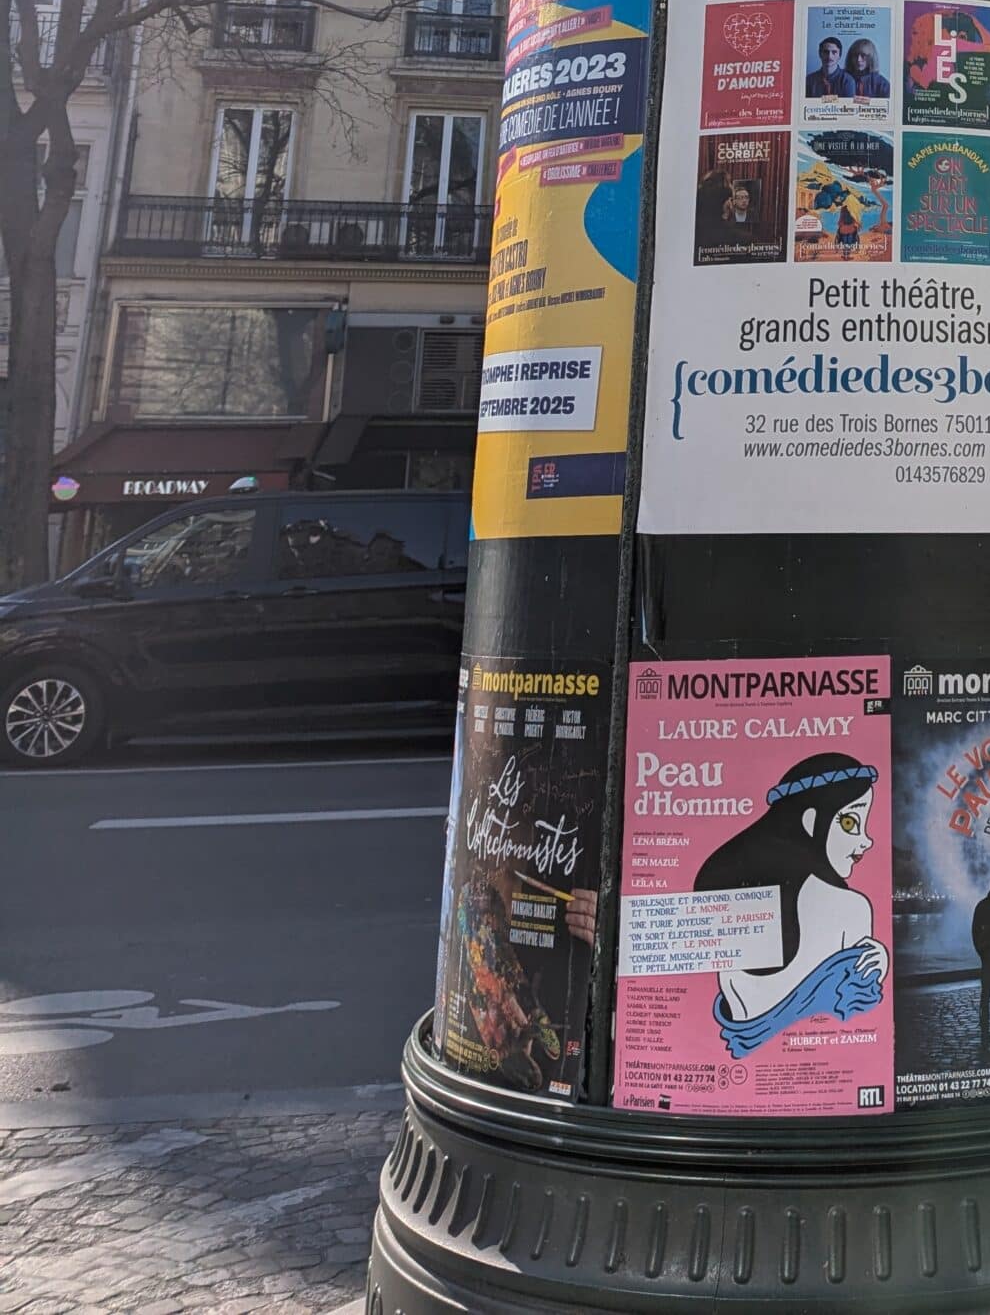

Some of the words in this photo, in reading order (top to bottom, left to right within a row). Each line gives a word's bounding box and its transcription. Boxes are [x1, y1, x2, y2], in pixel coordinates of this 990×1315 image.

[837, 7, 876, 15] réussite
[822, 21, 831, 29] le
[835, 21, 876, 29] charisme
[554, 52, 626, 84] 2023
[714, 61, 780, 76] HISTOIRES
[717, 76, 775, 91] D'AMOUR
[543, 103, 558, 131] DE
[560, 95, 612, 129] L'ANNÉE
[718, 139, 771, 151] CLÉMENT
[718, 148, 771, 160] CORBIAT
[935, 157, 963, 174] ON
[929, 176, 967, 196] PART
[920, 194, 949, 214] SUR
[954, 196, 978, 215] UN
[906, 212, 989, 234] SPECTACLE
[809, 278, 870, 308] Petit
[881, 278, 982, 315] théâtre,
[740, 313, 830, 351] grands
[520, 360, 591, 381] REPRISE
[529, 396, 576, 415] 2025
[745, 414, 766, 434] 32
[773, 418, 799, 434] rue
[805, 413, 834, 433] des
[839, 414, 878, 434] Trois
[884, 414, 938, 434] Bornes
[743, 438, 986, 458] www.comediedes3bornes.com
[895, 466, 986, 484] 0143576829
[123, 480, 209, 496] BROADWAY
[483, 670, 600, 700] montparnasse
[667, 669, 879, 700] MONTPARNASSE
[908, 689, 928, 697] petit
[926, 711, 962, 724] MARC
[658, 719, 738, 740] LAURE
[744, 716, 854, 738] CALAMY
[636, 752, 723, 787] Peau
[488, 755, 526, 807] Les
[936, 765, 966, 800] LE
[634, 790, 753, 816] d'Homme
[633, 836, 654, 846] LÉNA
[656, 835, 690, 846] BRÉBAN
[632, 859, 648, 867] BEN
[650, 857, 679, 867] MAZUÉ
[632, 879, 653, 888] LEÏLA
[656, 880, 667, 888] KA
[679, 897, 688, 905] ET
[735, 891, 773, 902] COMIQUE
[686, 906, 696, 914] LE
[700, 904, 729, 913] MONDE
[650, 920, 673, 928] FURIE
[722, 916, 733, 924] LE
[736, 912, 774, 923] PARISIEN
[645, 932, 664, 940] SORT
[718, 926, 750, 935] BLUFFÉ
[753, 925, 764, 933] ET
[632, 942, 668, 951] HEUREUX
[684, 940, 695, 948] LE
[698, 938, 722, 947] POINT
[670, 951, 710, 961] MUSICALE
[715, 949, 741, 958] FOLLE
[633, 965, 642, 973] ET
[646, 961, 694, 973] PÉTILLANTE
[711, 959, 733, 968] TÊTU
[790, 1036, 827, 1046] HUBERT
[830, 1036, 838, 1045] et
[840, 1034, 877, 1044] ZANZIM
[625, 1071, 661, 1081] LOCATION
[663, 1073, 671, 1081] 01
[674, 1074, 682, 1082] 43
[684, 1074, 693, 1082] 22
[695, 1074, 704, 1083] 77
[706, 1074, 715, 1083] 74
[896, 1083, 937, 1095] LOCATION
[938, 1083, 948, 1091] 01
[950, 1081, 959, 1090] 43
[961, 1080, 970, 1089] 22
[972, 1079, 980, 1088] 77
[982, 1078, 990, 1087] 74
[630, 1094, 655, 1108] Parisien
[860, 1088, 882, 1106] RTL
